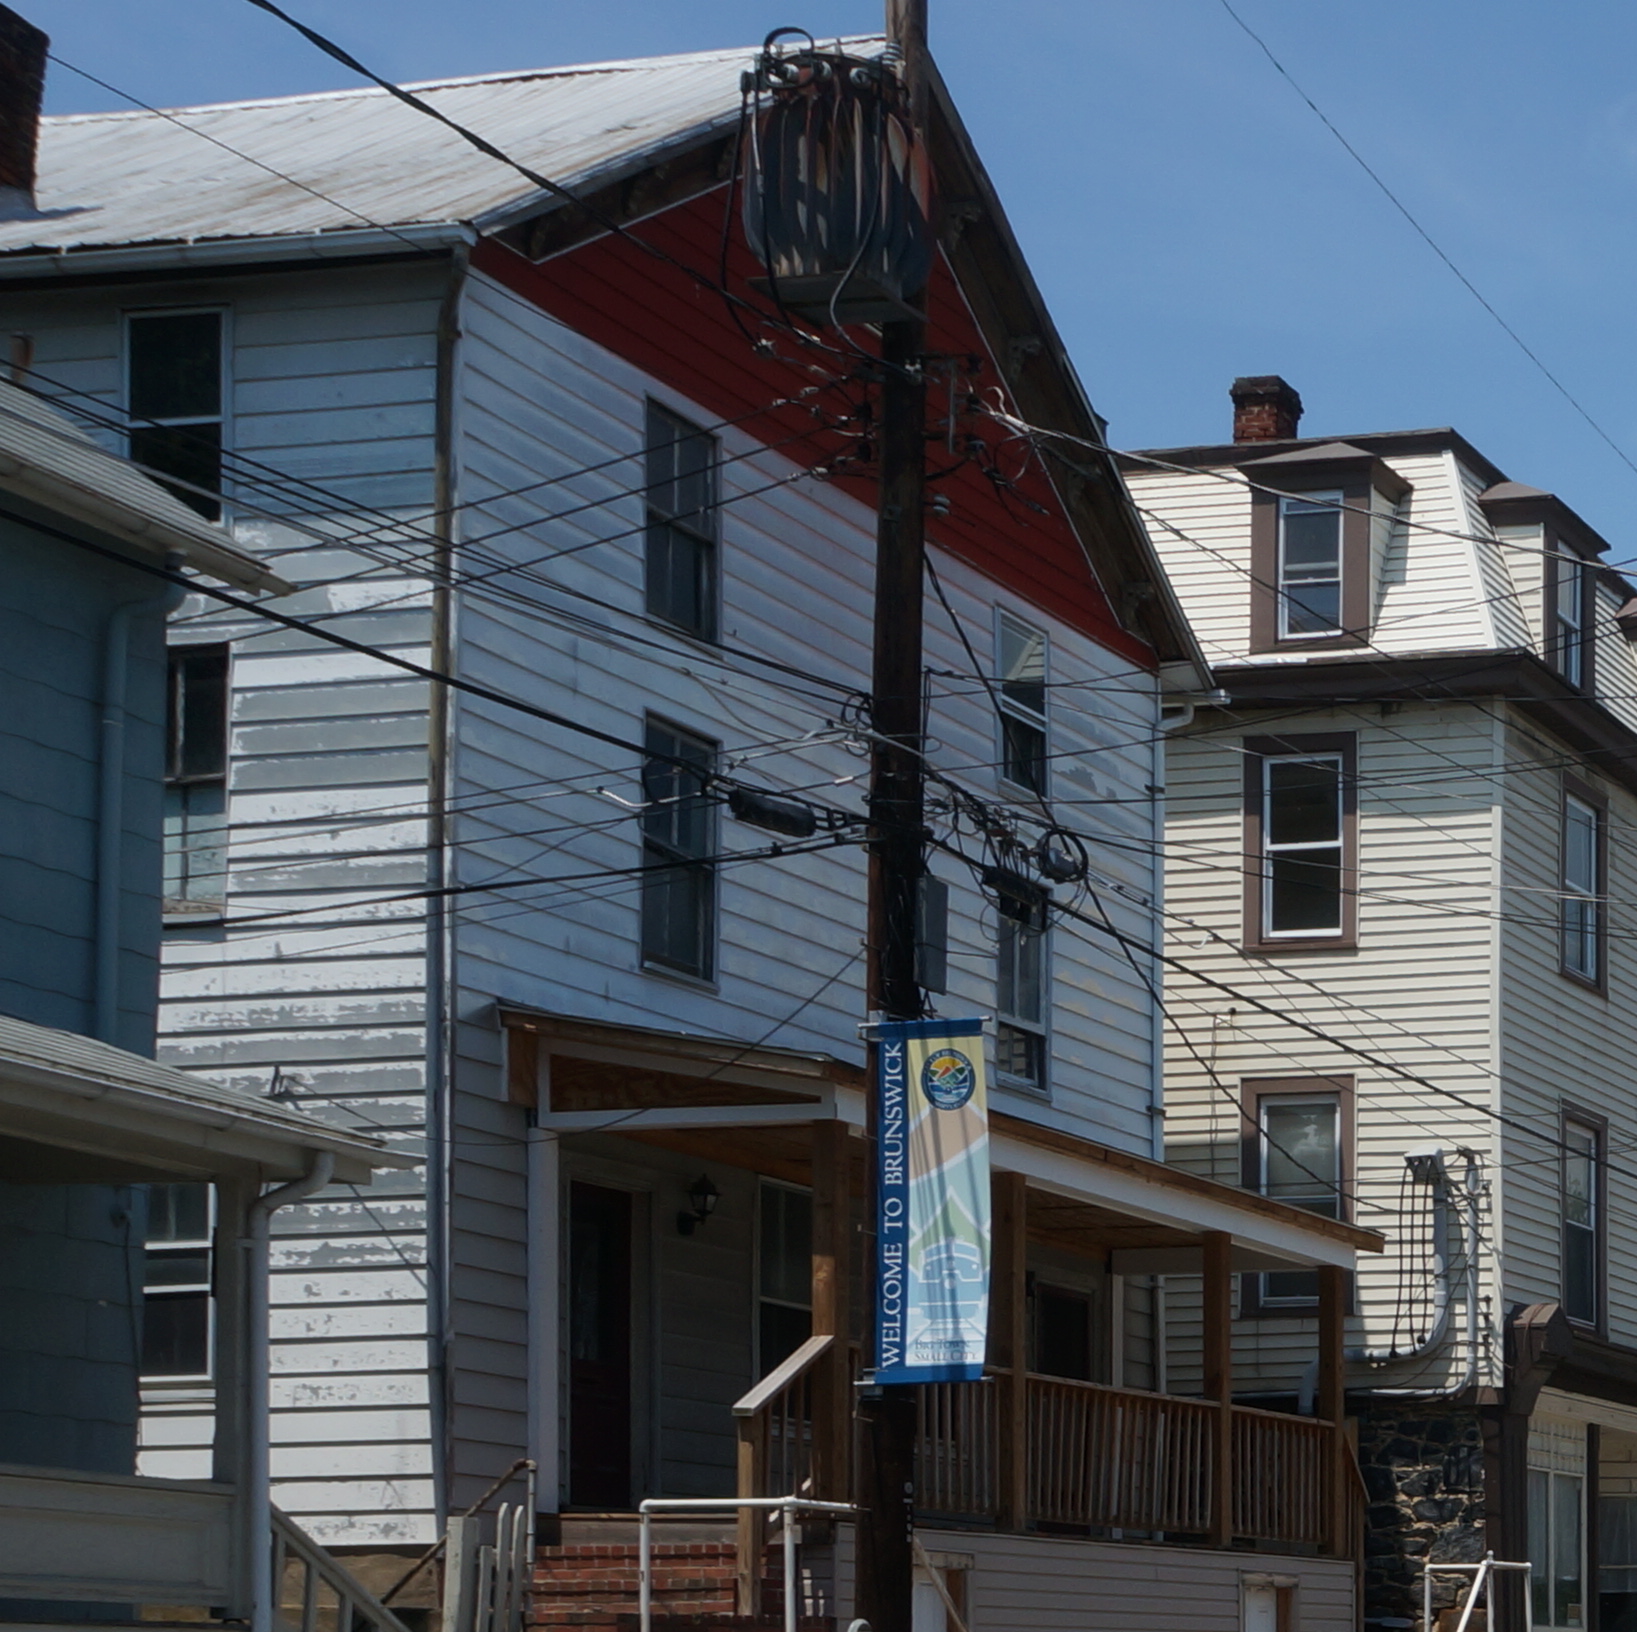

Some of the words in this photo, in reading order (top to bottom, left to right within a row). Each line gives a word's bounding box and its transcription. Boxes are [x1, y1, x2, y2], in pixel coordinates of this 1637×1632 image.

[884, 1041, 903, 1185] BRUNSWICK
[884, 1197, 903, 1234] TO
[882, 1243, 903, 1368] WELCOME
